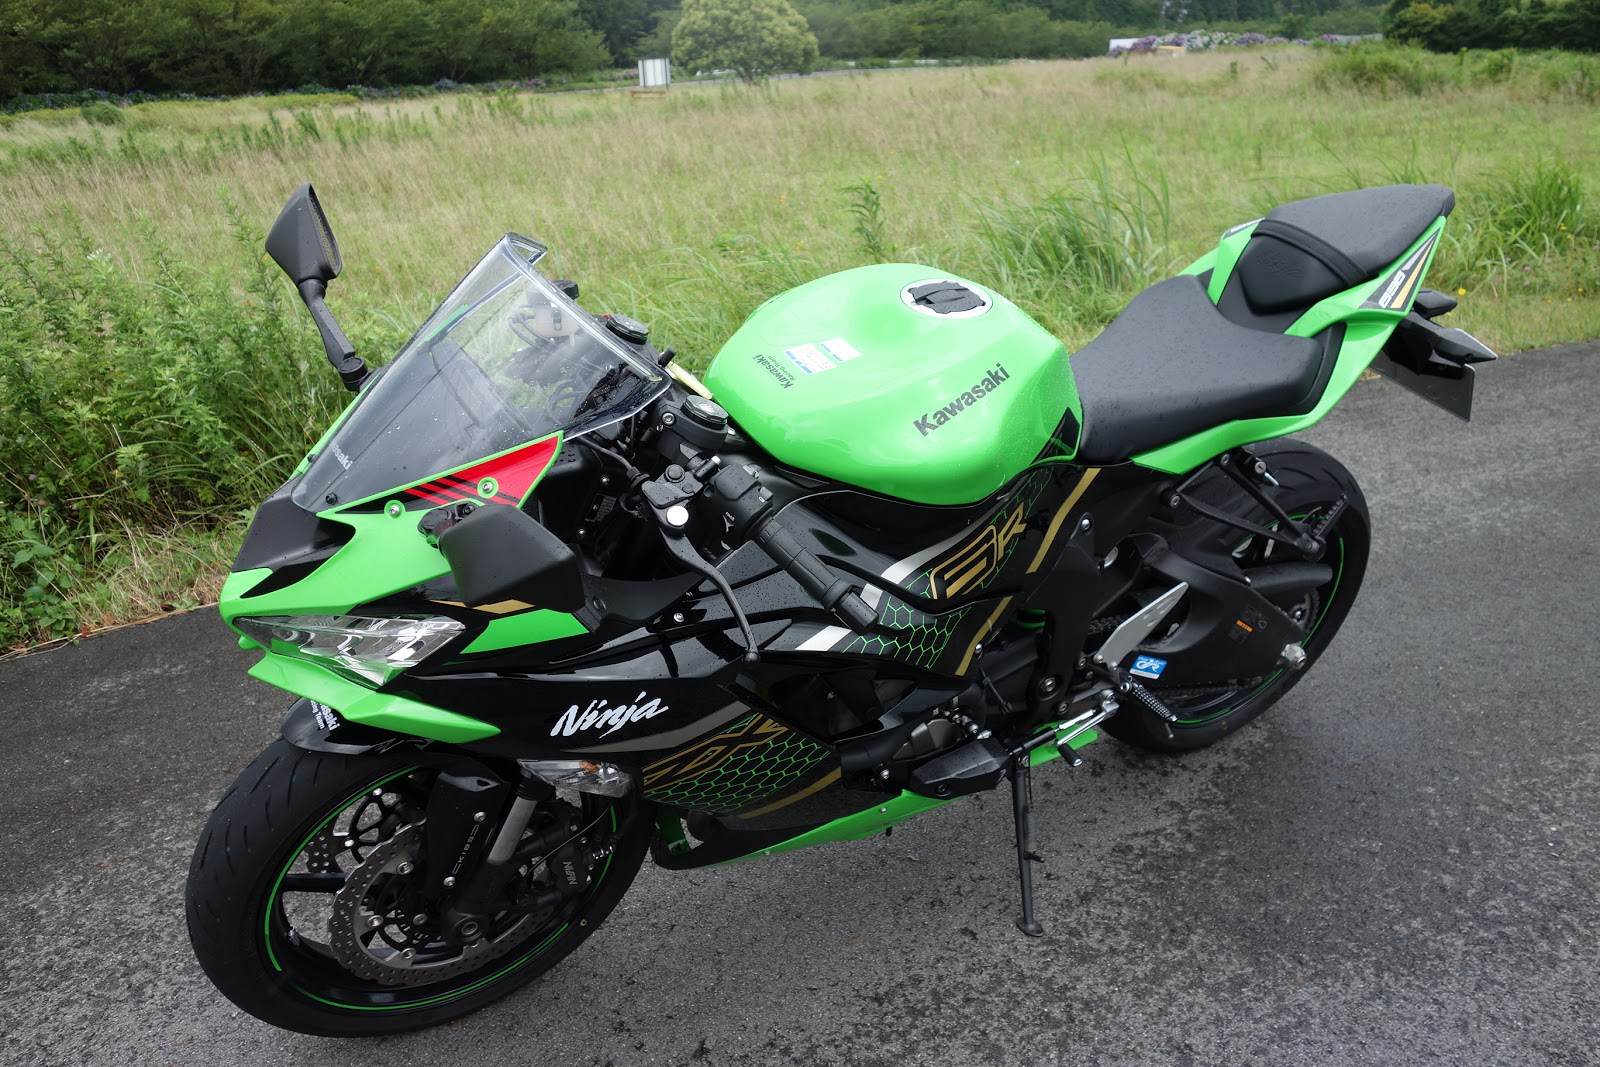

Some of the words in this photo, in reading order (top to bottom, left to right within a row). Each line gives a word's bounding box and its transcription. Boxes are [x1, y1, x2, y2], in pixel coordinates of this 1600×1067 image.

[753, 354, 794, 389] Kawasaki
[913, 362, 1011, 437] Kawasaki
[332, 444, 354, 470] asaki
[320, 703, 340, 730] asaki
[549, 690, 669, 739] Ninja
